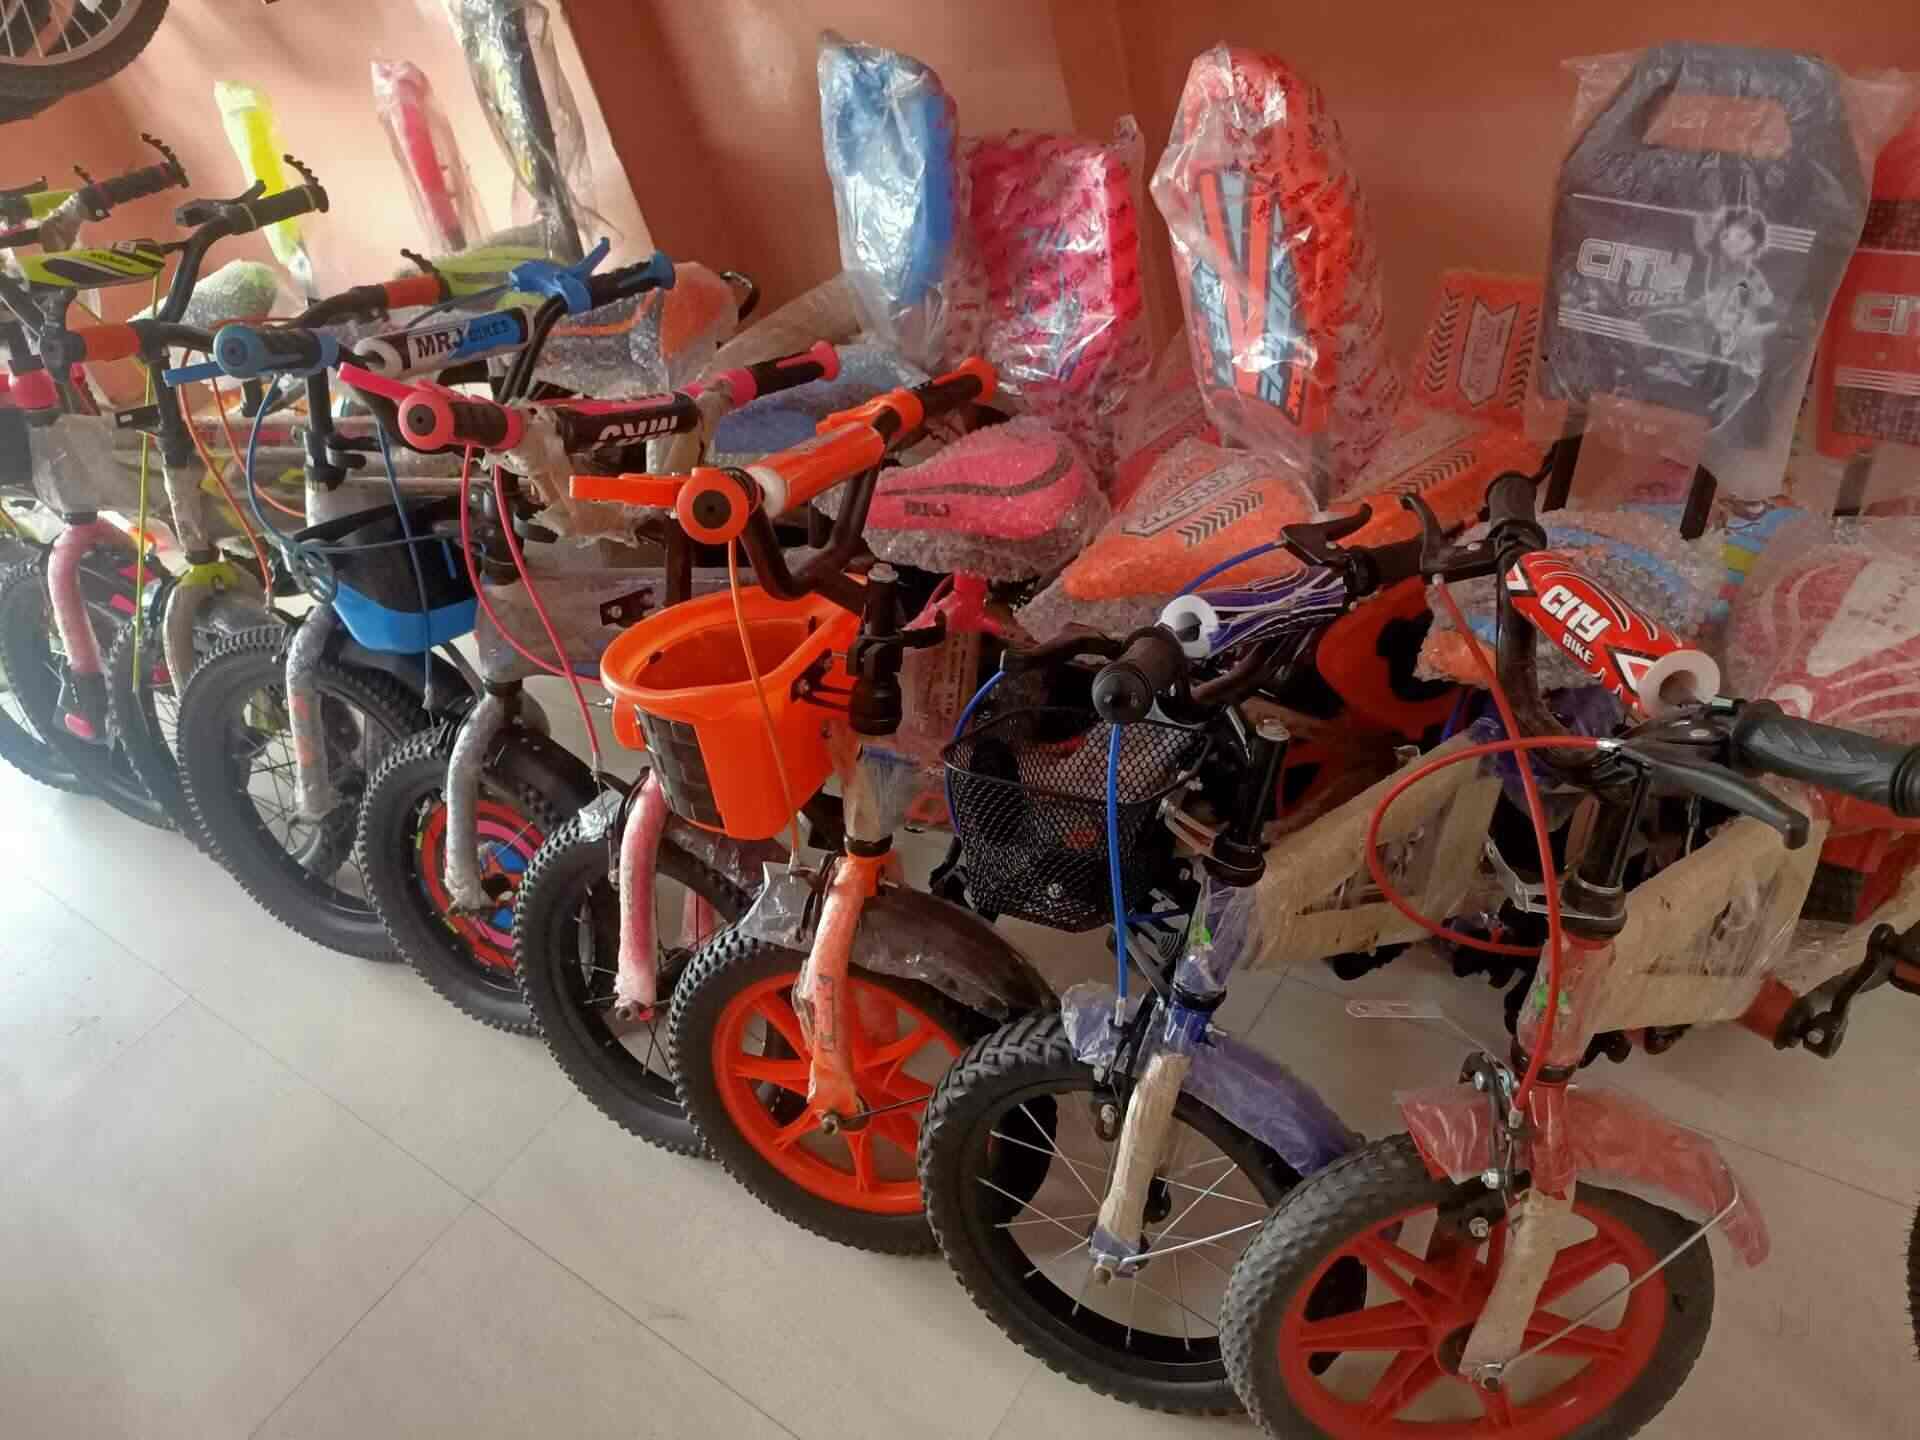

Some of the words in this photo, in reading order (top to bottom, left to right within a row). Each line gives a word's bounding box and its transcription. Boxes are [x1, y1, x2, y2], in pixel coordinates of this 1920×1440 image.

[1576, 238, 1694, 292] CITY
[414, 324, 465, 359] MRJ
[1540, 584, 1612, 643] CITY
[1561, 631, 1595, 665] BIKE
